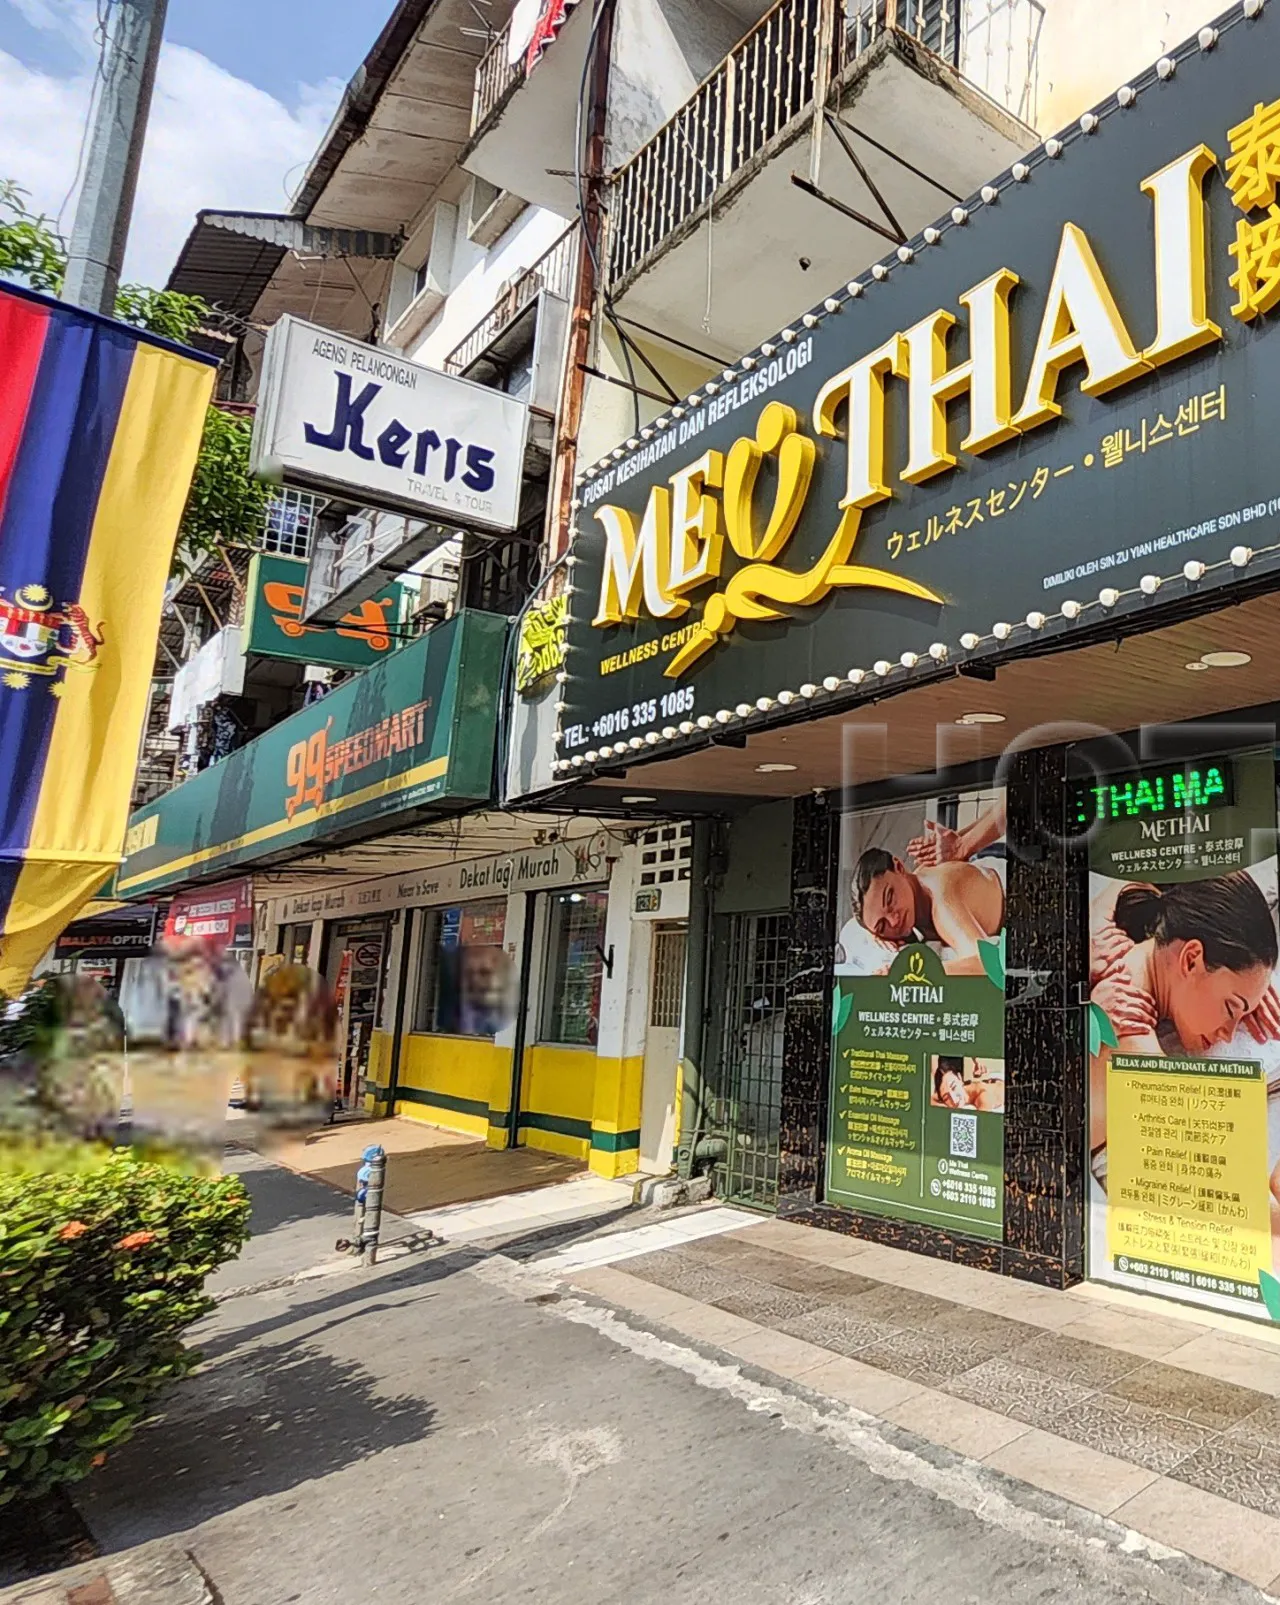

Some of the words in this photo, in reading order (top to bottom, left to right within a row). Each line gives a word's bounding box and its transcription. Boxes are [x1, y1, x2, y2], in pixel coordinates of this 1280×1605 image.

[312, 339, 346, 360] AGENSI
[352, 351, 417, 390] PELANCONGAN
[583, 470, 614, 508] PUSAT
[616, 428, 676, 485] KESIHATAN
[679, 411, 705, 446] DAN
[708, 337, 813, 426] REFLEKSOLOGI
[887, 463, 1075, 559] ウェルネスセンター
[1100, 384, 1227, 468] 웰니스센터
[407, 478, 448, 501] TRAVEL
[464, 496, 493, 513] TOUR
[1043, 572, 1075, 589] DIMILIKI
[1076, 564, 1099, 579] OLEH
[1100, 556, 1115, 570] SIN
[1116, 548, 1129, 562] ZU
[1130, 542, 1152, 558] YIAN
[1153, 520, 1217, 552] HEALTHCARE
[1218, 511, 1241, 530] SDN
[1243, 503, 1267, 522] BHD
[601, 640, 659, 676] WELLNESS
[564, 724, 589, 749] TEL:
[592, 708, 629, 738] +6016
[632, 699, 657, 727] 335
[660, 685, 695, 718] 1085
[1090, 777, 1164, 819] THAI
[1173, 768, 1224, 807] MA
[1139, 813, 1211, 843] METHAI
[518, 849, 559, 881] Murah
[1111, 848, 1157, 862] WELLNESS
[1159, 844, 1196, 857] CENTRE
[890, 984, 944, 1007] METHAI
[858, 1011, 900, 1023] WELLNESS
[901, 1013, 935, 1025] CENTRE
[1115, 1057, 1140, 1068] RELAX
[1140, 1059, 1158, 1069] AND
[1158, 1060, 1207, 1073] REJUVENATE
[1207, 1063, 1219, 1073] AT
[1131, 1080, 1177, 1092] Rheumatism
[1179, 1083, 1202, 1094] Relief
[1192, 1099, 1226, 1112] リウマチ
[1137, 1113, 1166, 1125] Arthritis
[1168, 1116, 1186, 1126] Care
[1146, 1146, 1163, 1157] Pain
[1165, 1148, 1187, 1160] Relief
[1135, 1177, 1167, 1191] Migraine
[1169, 1181, 1192, 1193] Relief
[1143, 1211, 1166, 1225] Stress
[1177, 1217, 1206, 1231] Tension
[1209, 1222, 1233, 1235] Relief
[1129, 1262, 1148, 1273] +603
[1150, 1266, 1169, 1278] 2110
[1170, 1269, 1190, 1283] 1085
